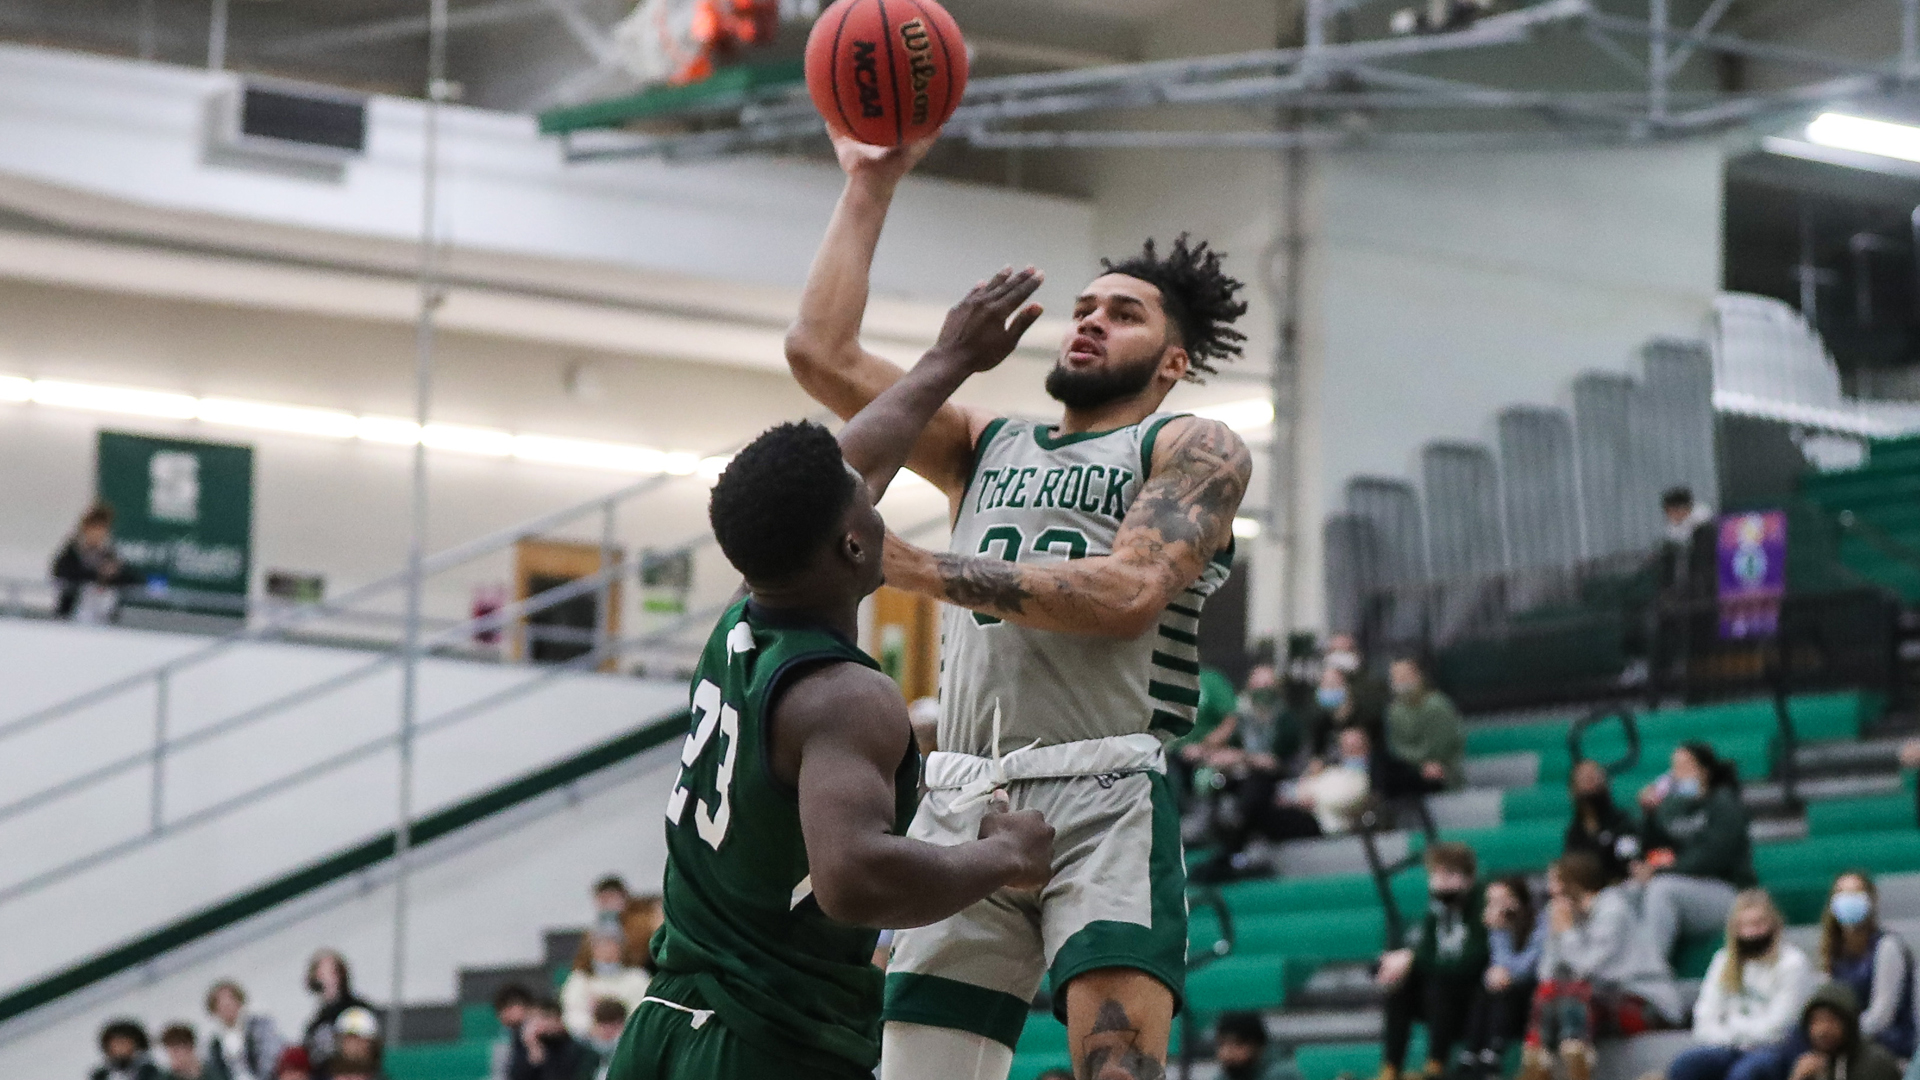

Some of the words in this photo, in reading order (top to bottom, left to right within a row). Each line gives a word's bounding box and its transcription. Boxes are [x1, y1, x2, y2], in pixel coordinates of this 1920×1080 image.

[853, 40, 884, 118] NCAA
[900, 18, 936, 125] Wilson
[975, 465, 1038, 515] THE
[1033, 464, 1134, 519] ROCK
[665, 678, 738, 850] 23
